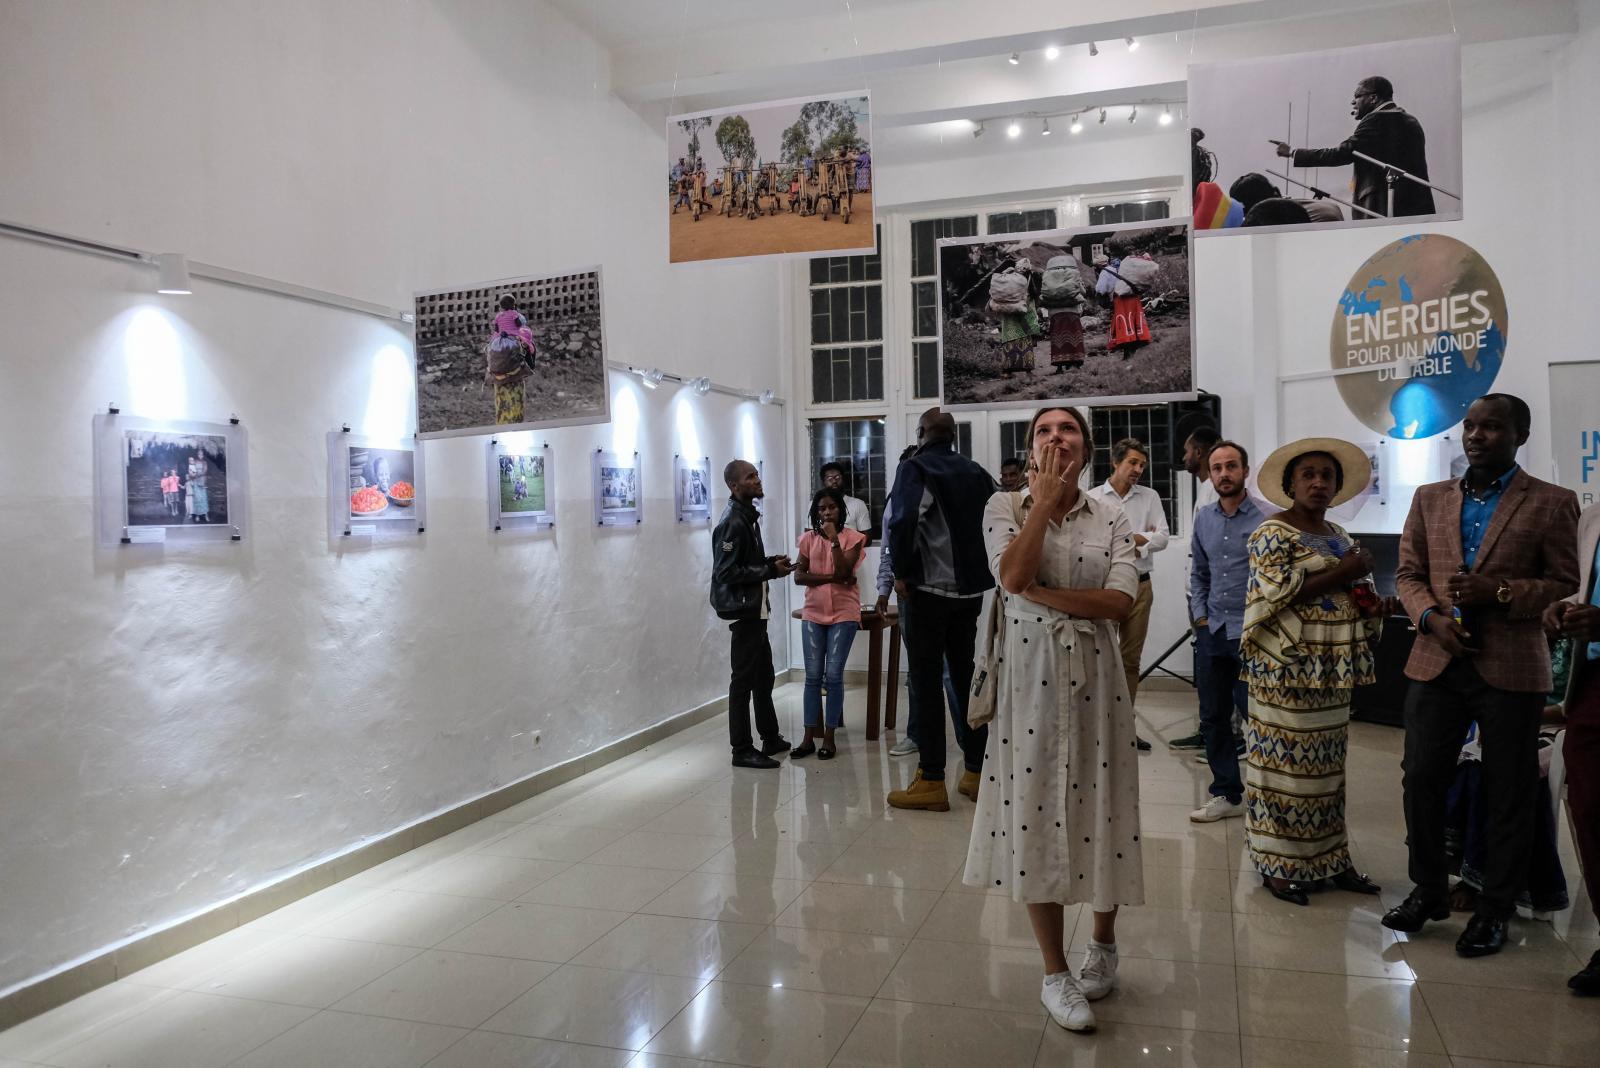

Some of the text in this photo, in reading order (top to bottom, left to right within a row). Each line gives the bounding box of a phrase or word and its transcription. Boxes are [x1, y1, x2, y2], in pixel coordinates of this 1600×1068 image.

[1347, 329, 1487, 367] POUR UN MONDE
[1378, 356, 1452, 382] DUABLE
